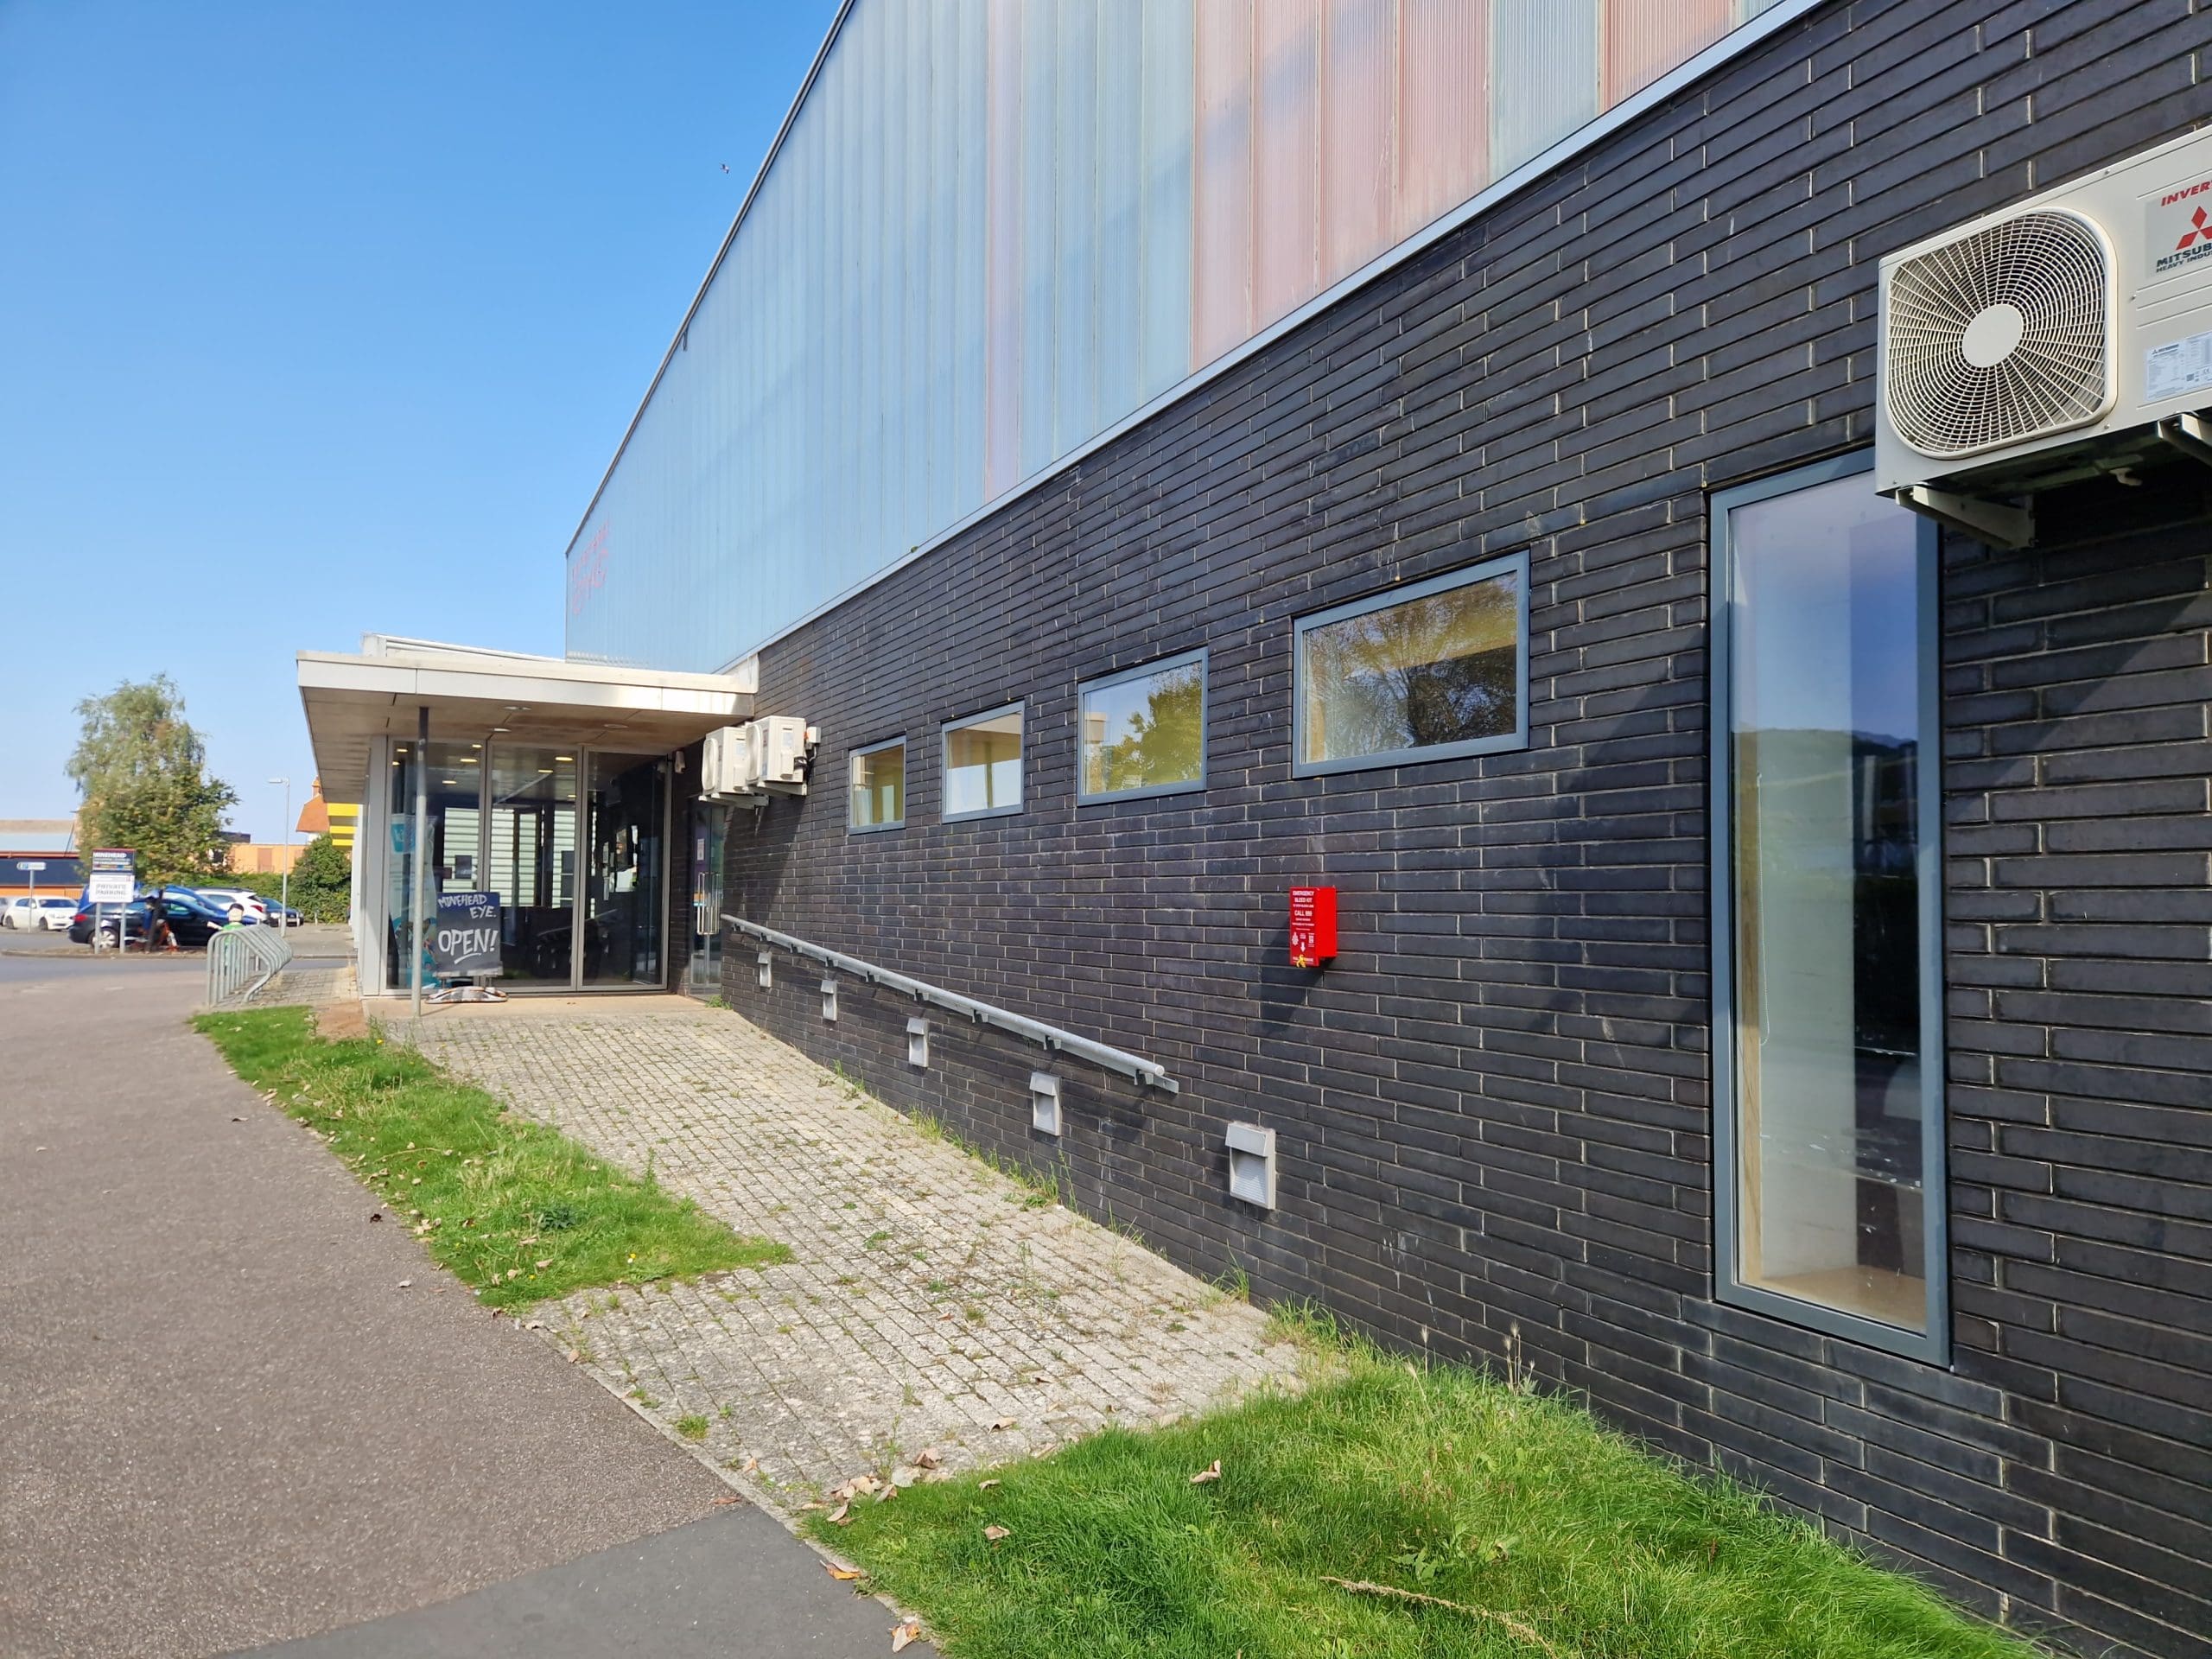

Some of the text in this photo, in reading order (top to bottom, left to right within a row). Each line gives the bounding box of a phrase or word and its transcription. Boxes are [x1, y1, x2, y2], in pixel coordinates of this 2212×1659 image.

[2161, 180, 2212, 207] INVER
[2156, 259, 2184, 273] HEAVY
[437, 893, 487, 909] MINEHEAD
[437, 928, 499, 956] OPEN!
